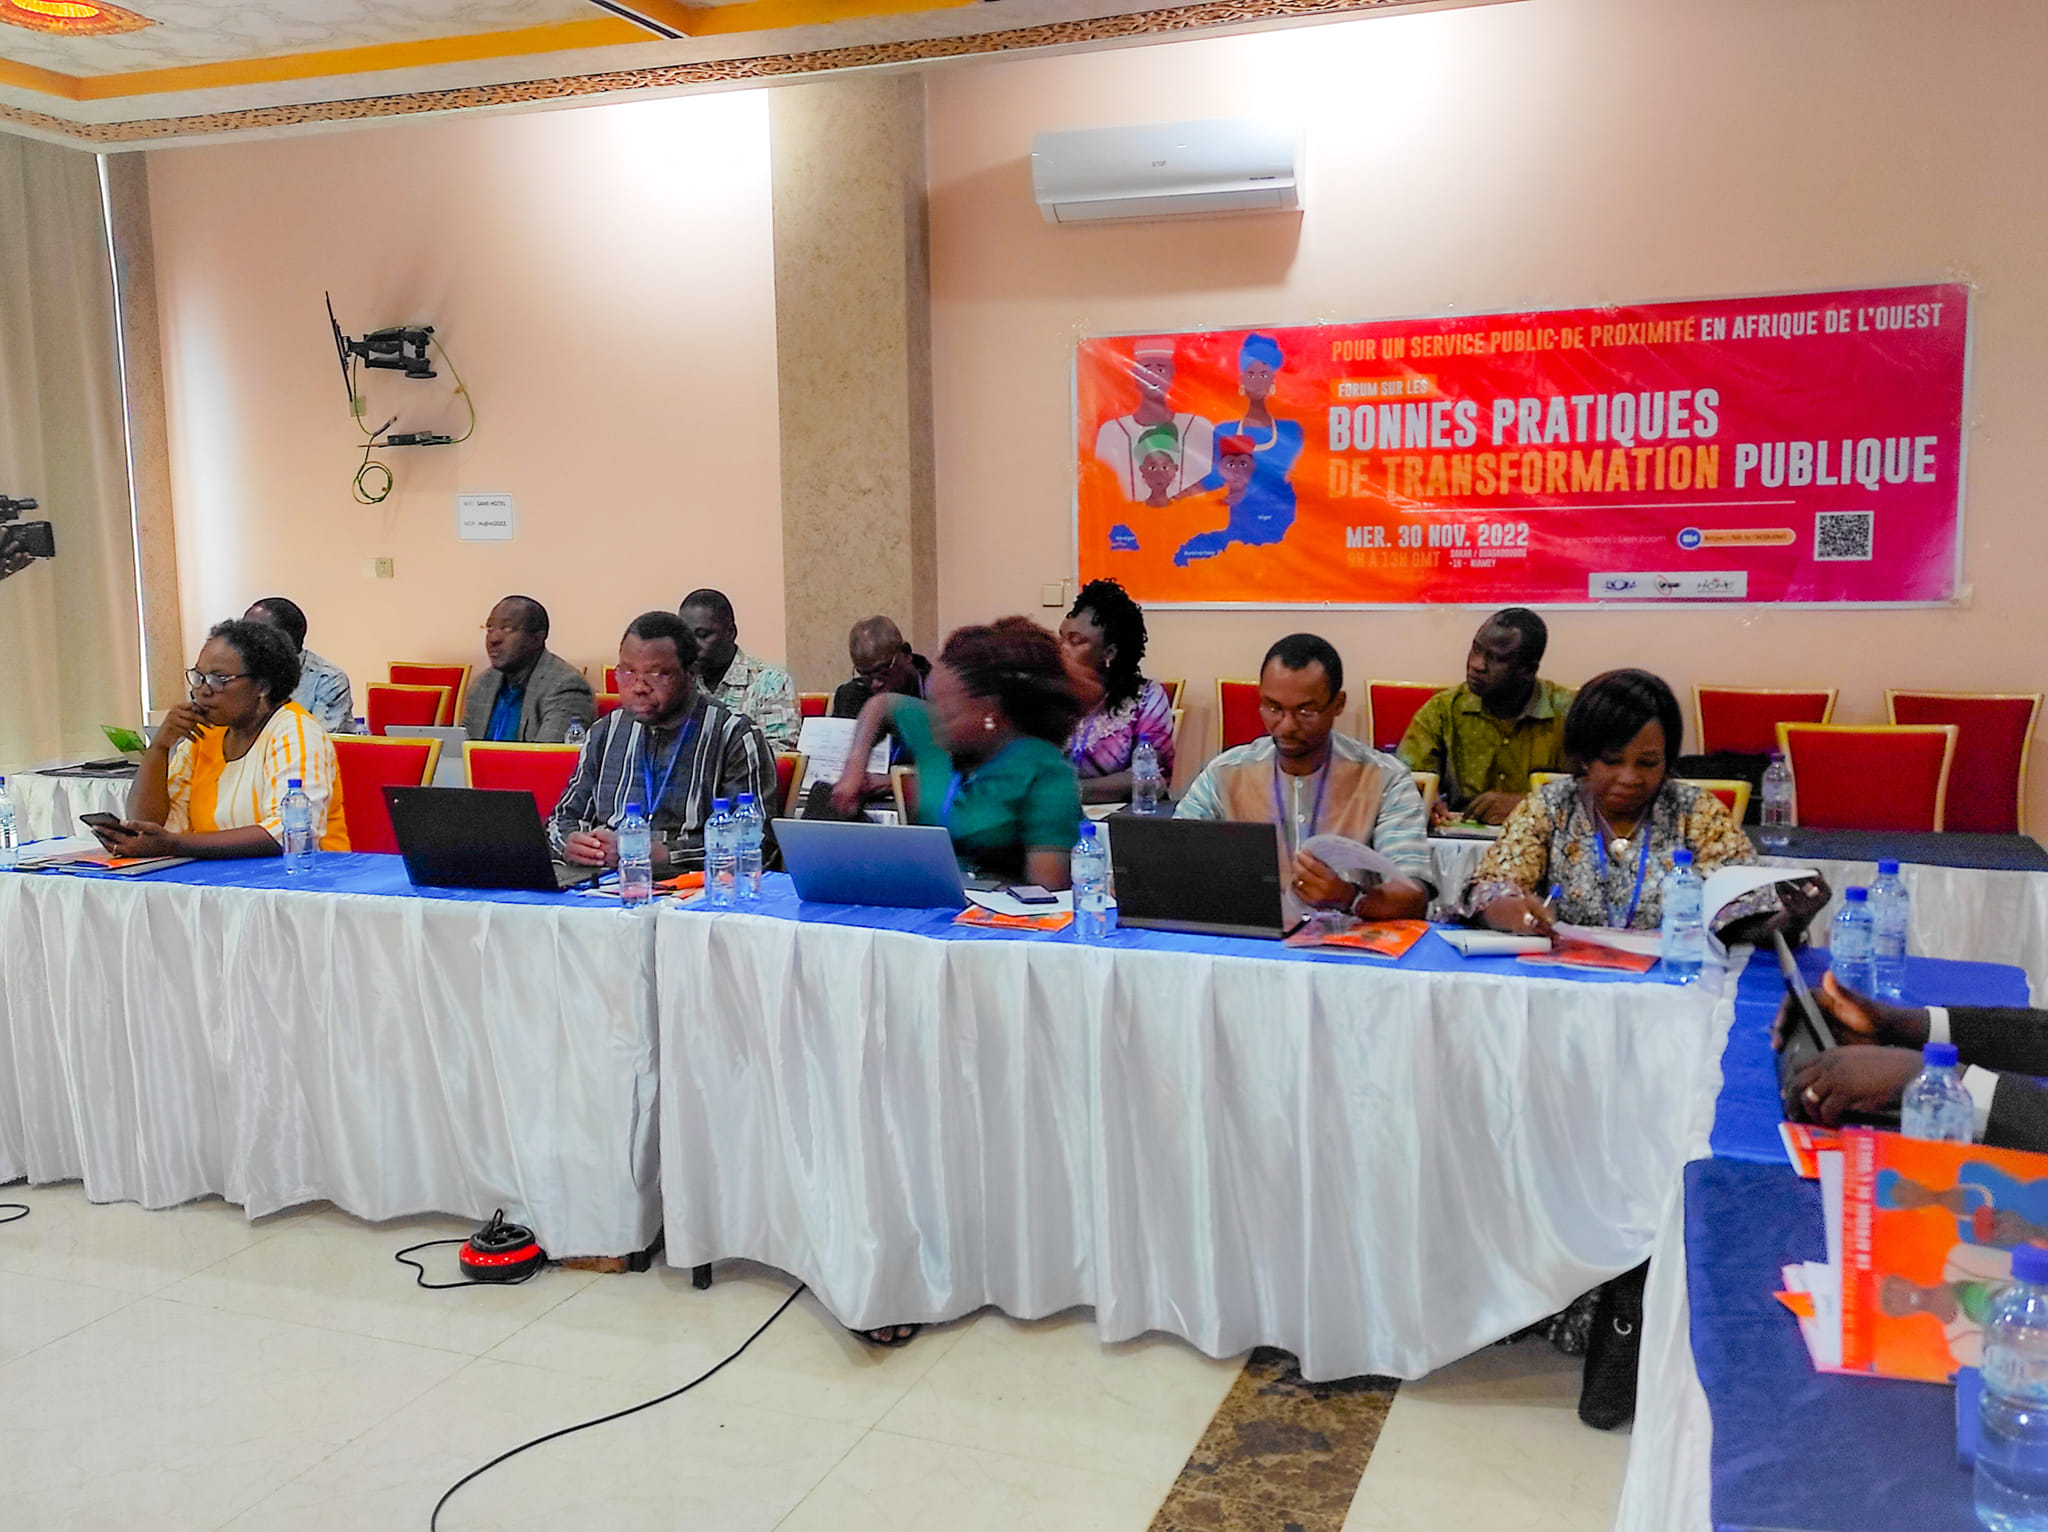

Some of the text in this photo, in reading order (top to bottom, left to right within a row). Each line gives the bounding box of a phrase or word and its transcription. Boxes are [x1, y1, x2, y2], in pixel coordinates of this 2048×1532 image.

[1331, 302, 1944, 362] POUR UN SERVICE PUBLIC DE PROXIMITÉ EN AFRIQUE DE L'OUEST
[1338, 378, 1428, 398] FORUM SUR LES
[1328, 387, 1720, 451] BONNES PRATIQUES
[1327, 435, 1938, 499] DE TRANSFORMATION PUBLIQUE
[1345, 522, 1529, 548] MER. 30 NOV. 2022
[1412, 550, 1441, 568] GMT
